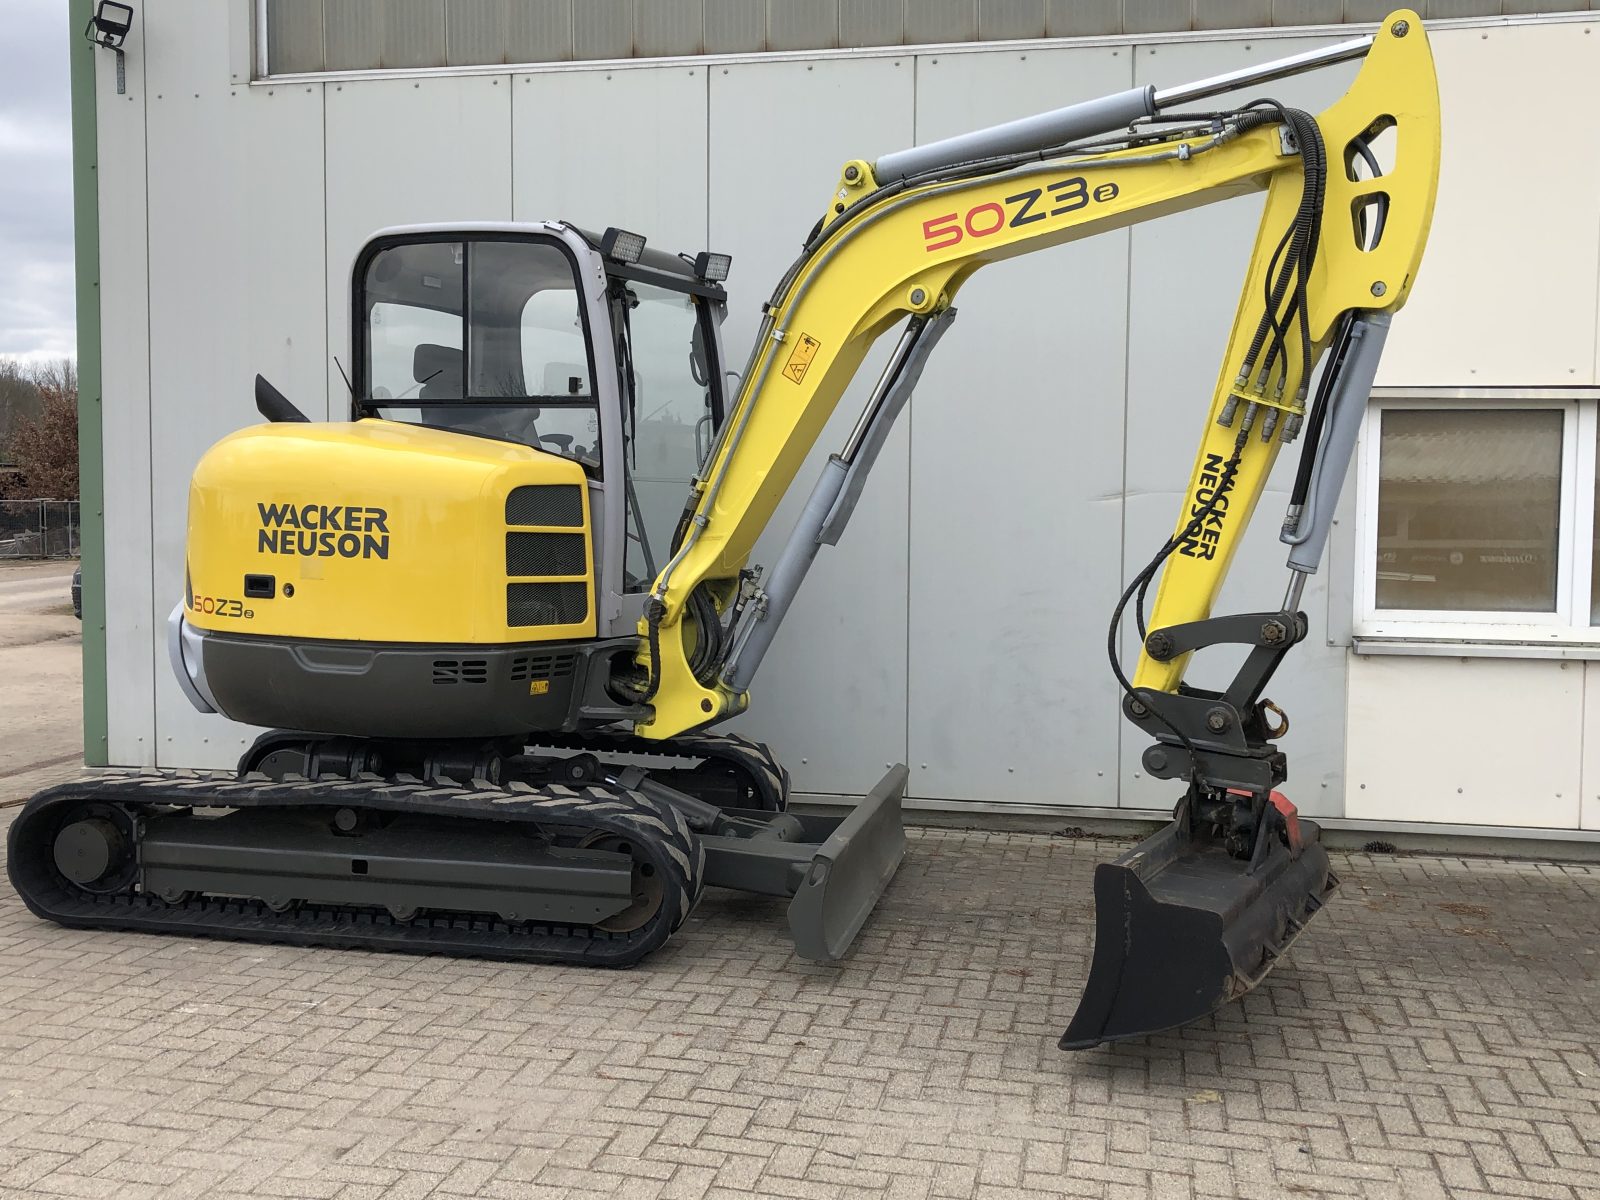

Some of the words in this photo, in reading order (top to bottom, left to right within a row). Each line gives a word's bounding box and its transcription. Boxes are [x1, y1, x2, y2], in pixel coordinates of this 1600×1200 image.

[257, 502, 390, 533] WACKER
[1179, 453, 1224, 557] NEUSON
[258, 529, 390, 560] NEUSON
